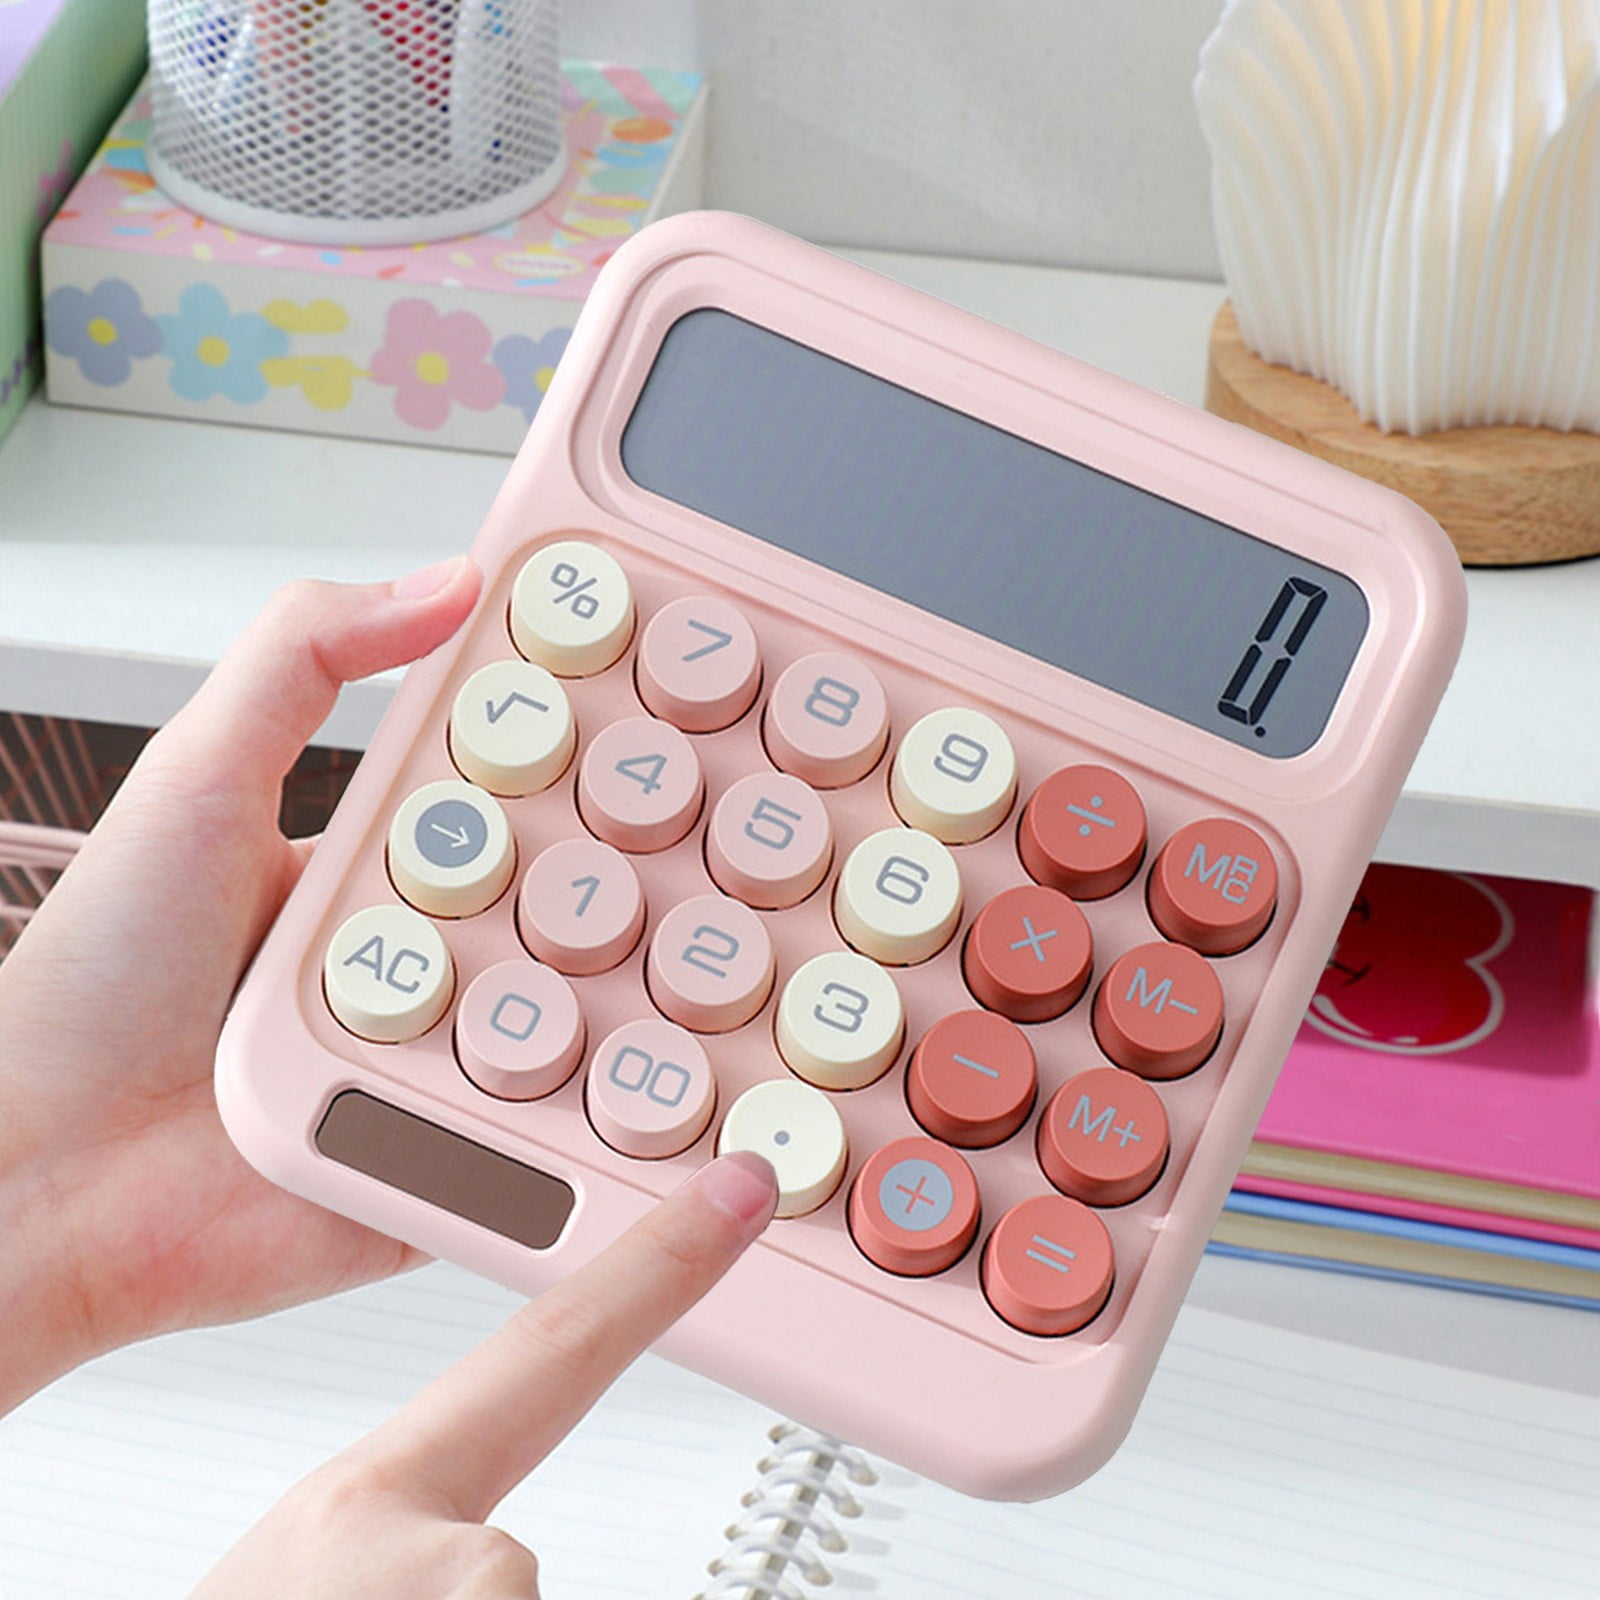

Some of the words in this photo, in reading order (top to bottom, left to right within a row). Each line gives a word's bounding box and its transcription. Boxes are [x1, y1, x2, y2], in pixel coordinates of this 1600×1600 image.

[550, 562, 599, 620] %
[681, 619, 733, 662] 7
[1217, 576, 1328, 737] 0.
[805, 676, 860, 727] 8
[615, 754, 667, 795] 4
[933, 733, 989, 783] 9
[744, 798, 802, 850] 5
[571, 876, 600, 917] 1
[875, 855, 929, 905] 6
[342, 935, 430, 994] AC
[681, 925, 740, 979] 2
[490, 993, 542, 1042] 0
[813, 981, 869, 1034] 3
[609, 1045, 691, 1108] 00
[1068, 1094, 1141, 1148] M+
[1026, 1234, 1077, 1274] =
